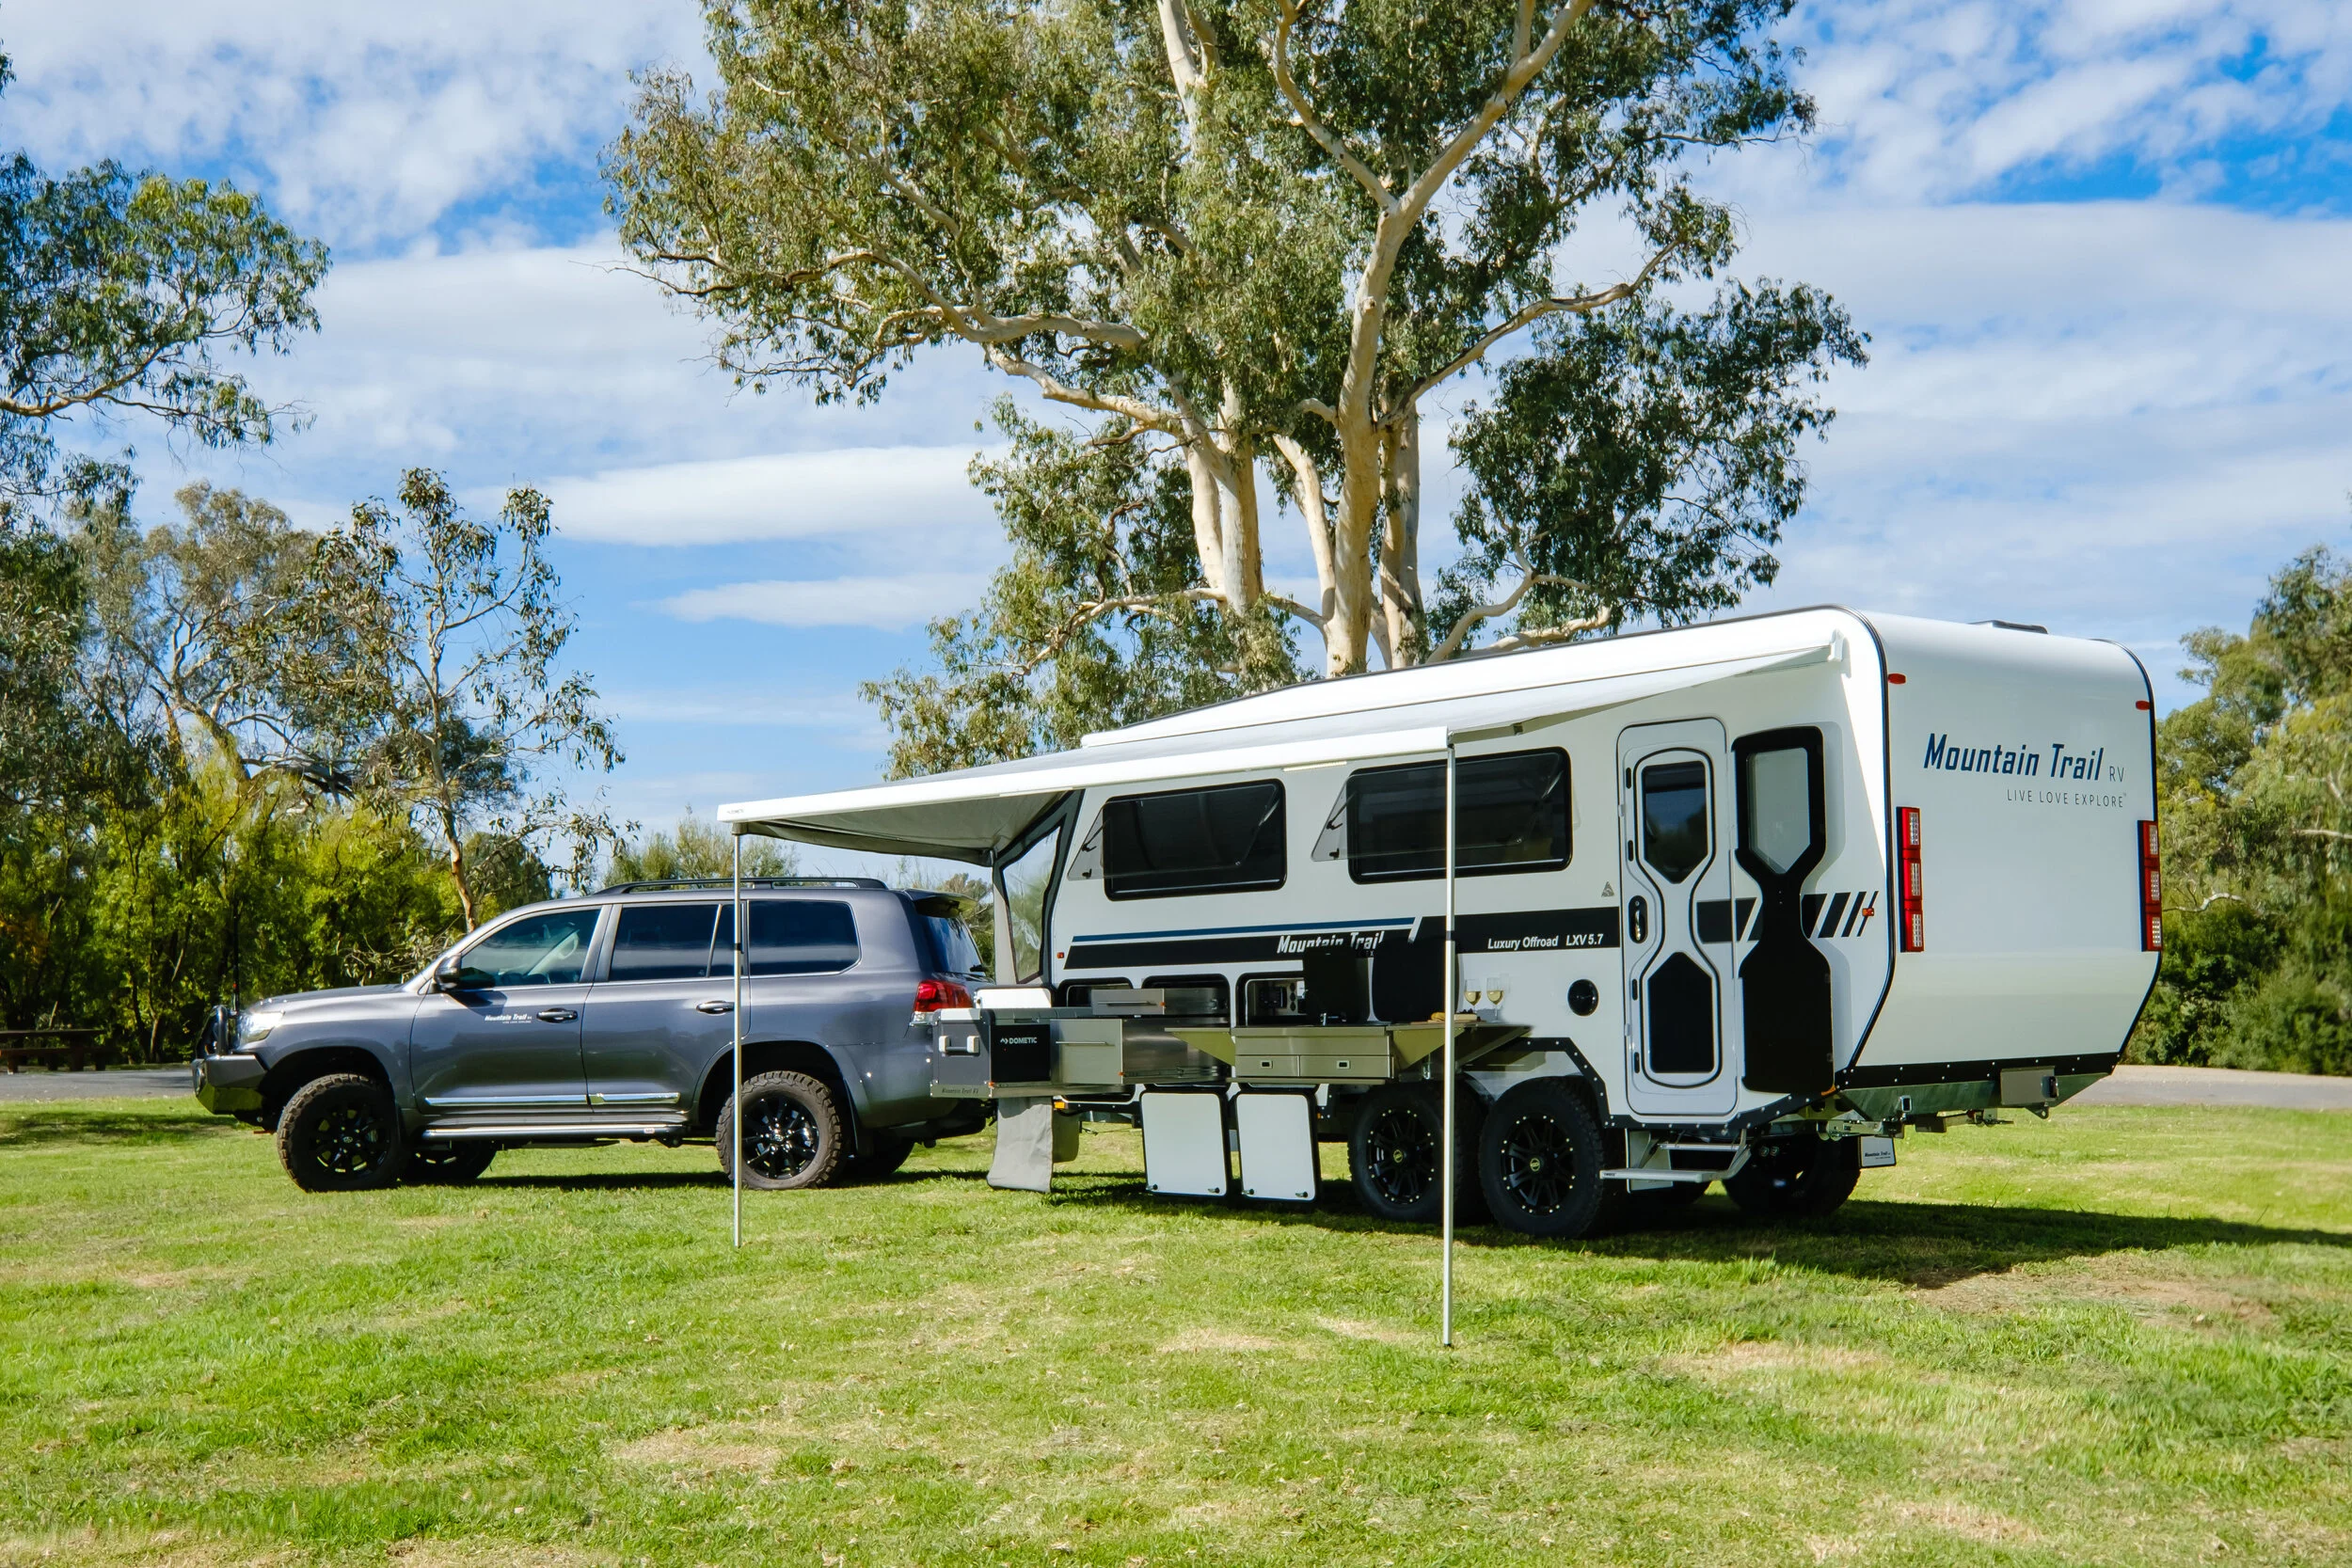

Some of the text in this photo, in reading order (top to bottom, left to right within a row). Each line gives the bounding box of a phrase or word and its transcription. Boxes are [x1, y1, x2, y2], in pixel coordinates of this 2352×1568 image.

[1923, 733, 2125, 783] Mountain Trail RV
[2007, 789, 2123, 808] LIVE LOVE EXPLORE
[1487, 933, 1604, 951] Luxury Offroad LXV 5.7
